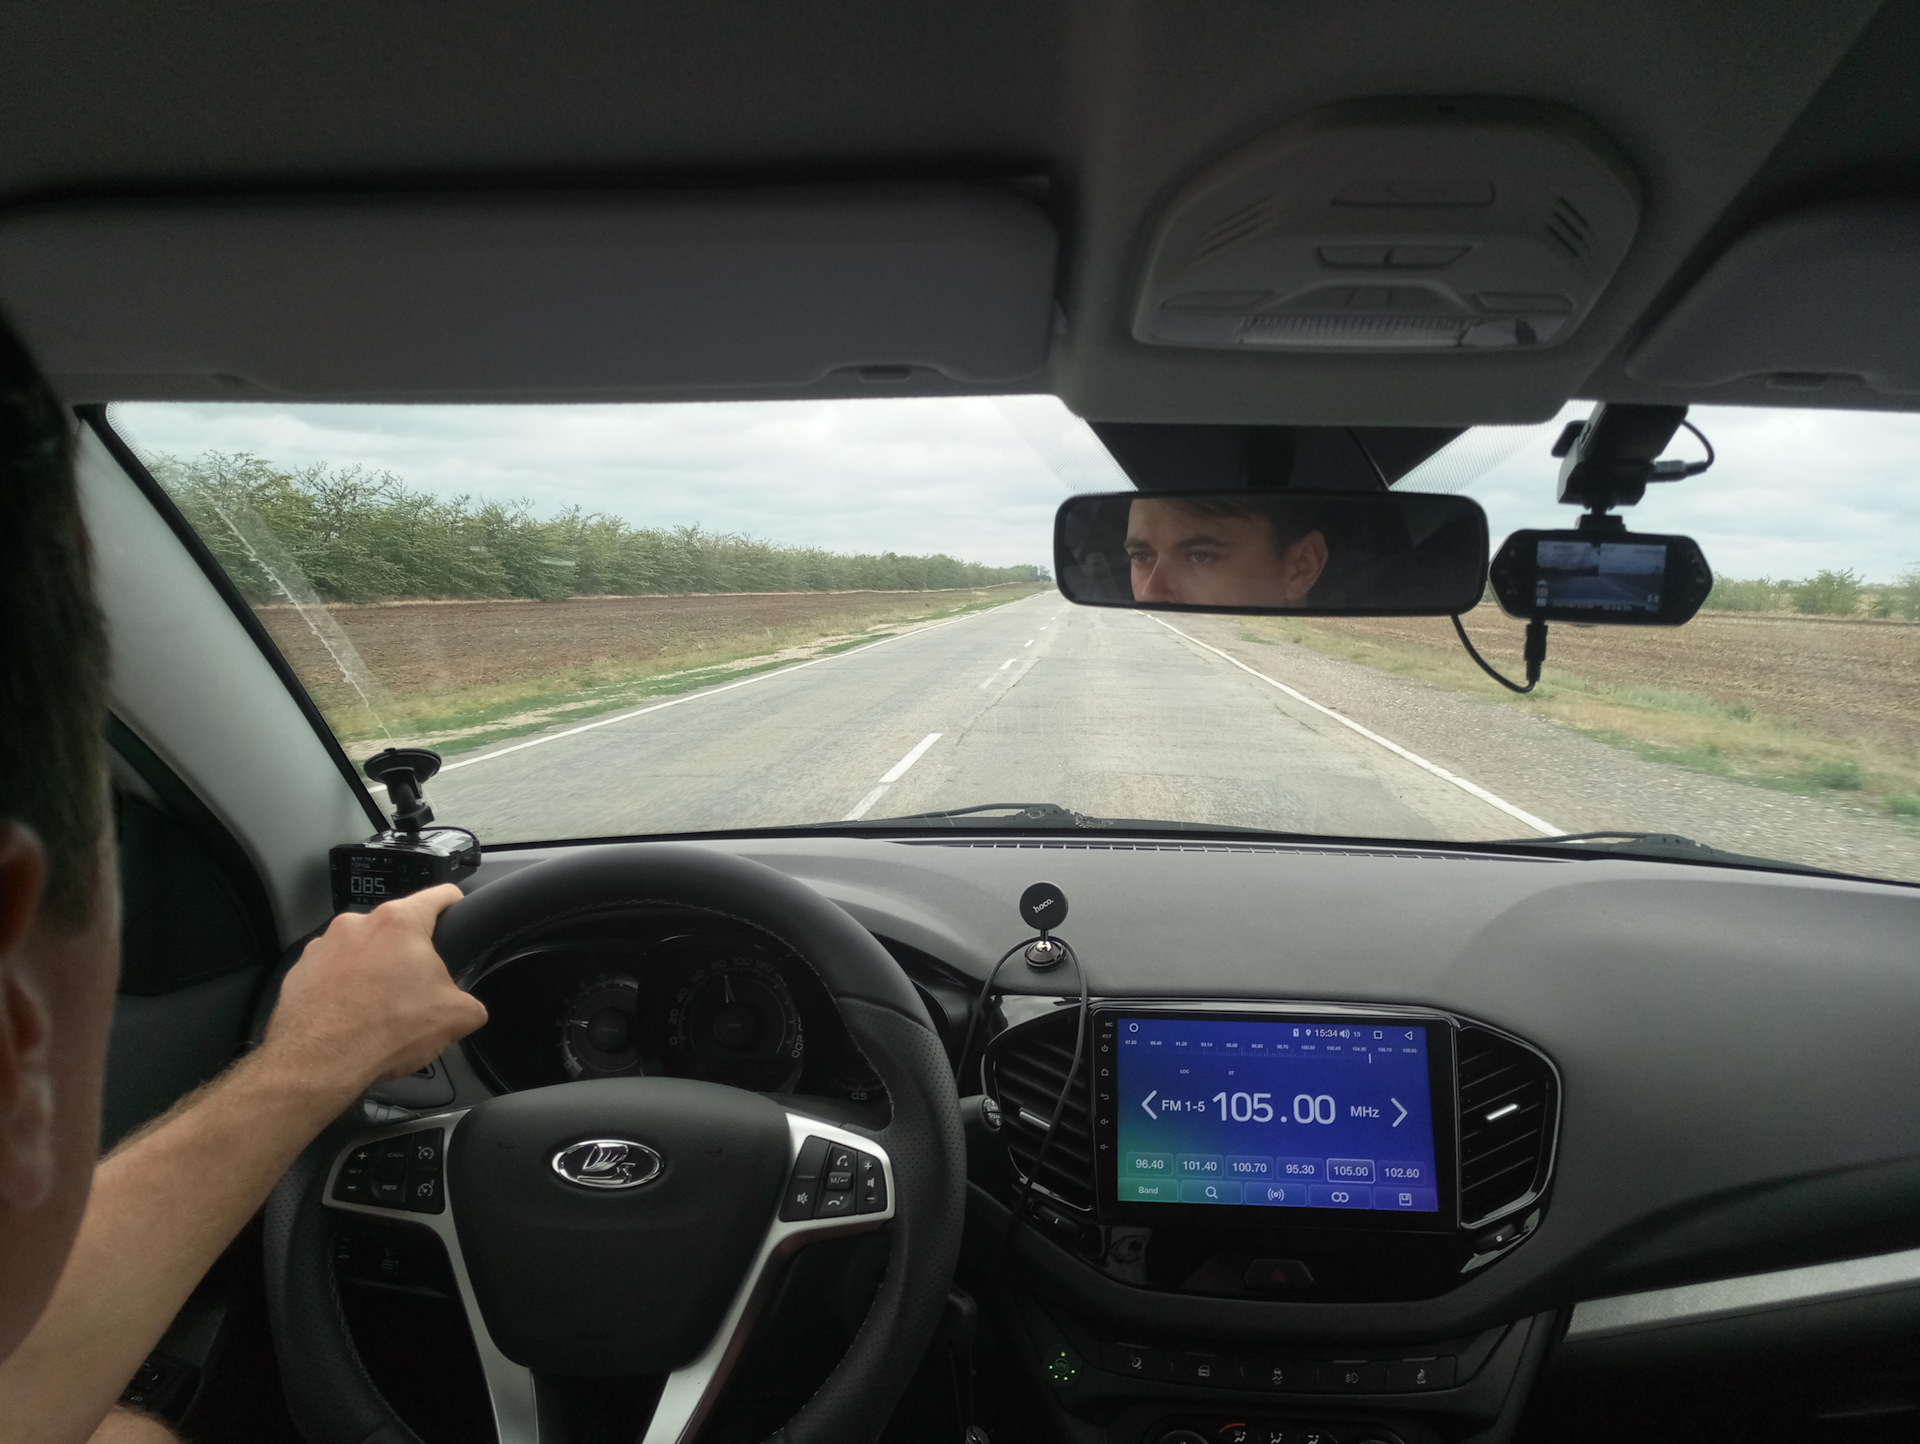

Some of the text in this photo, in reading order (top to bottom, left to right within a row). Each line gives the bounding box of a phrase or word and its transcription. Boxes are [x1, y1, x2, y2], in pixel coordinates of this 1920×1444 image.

[351, 876, 386, 895] 085
[1314, 1028, 1338, 1038] 15:34
[1161, 1099, 1206, 1113] FM 1-5
[1211, 1091, 1337, 1125] 105.00
[1350, 1105, 1381, 1119] MHz
[1135, 1158, 1164, 1170] 96.40
[1183, 1160, 1217, 1172] 101.40
[1232, 1162, 1267, 1173] 100.70
[1286, 1164, 1315, 1175] 95.30
[1333, 1166, 1369, 1177] 105.00
[1384, 1167, 1420, 1179] 102.60
[1138, 1186, 1159, 1195] Band
